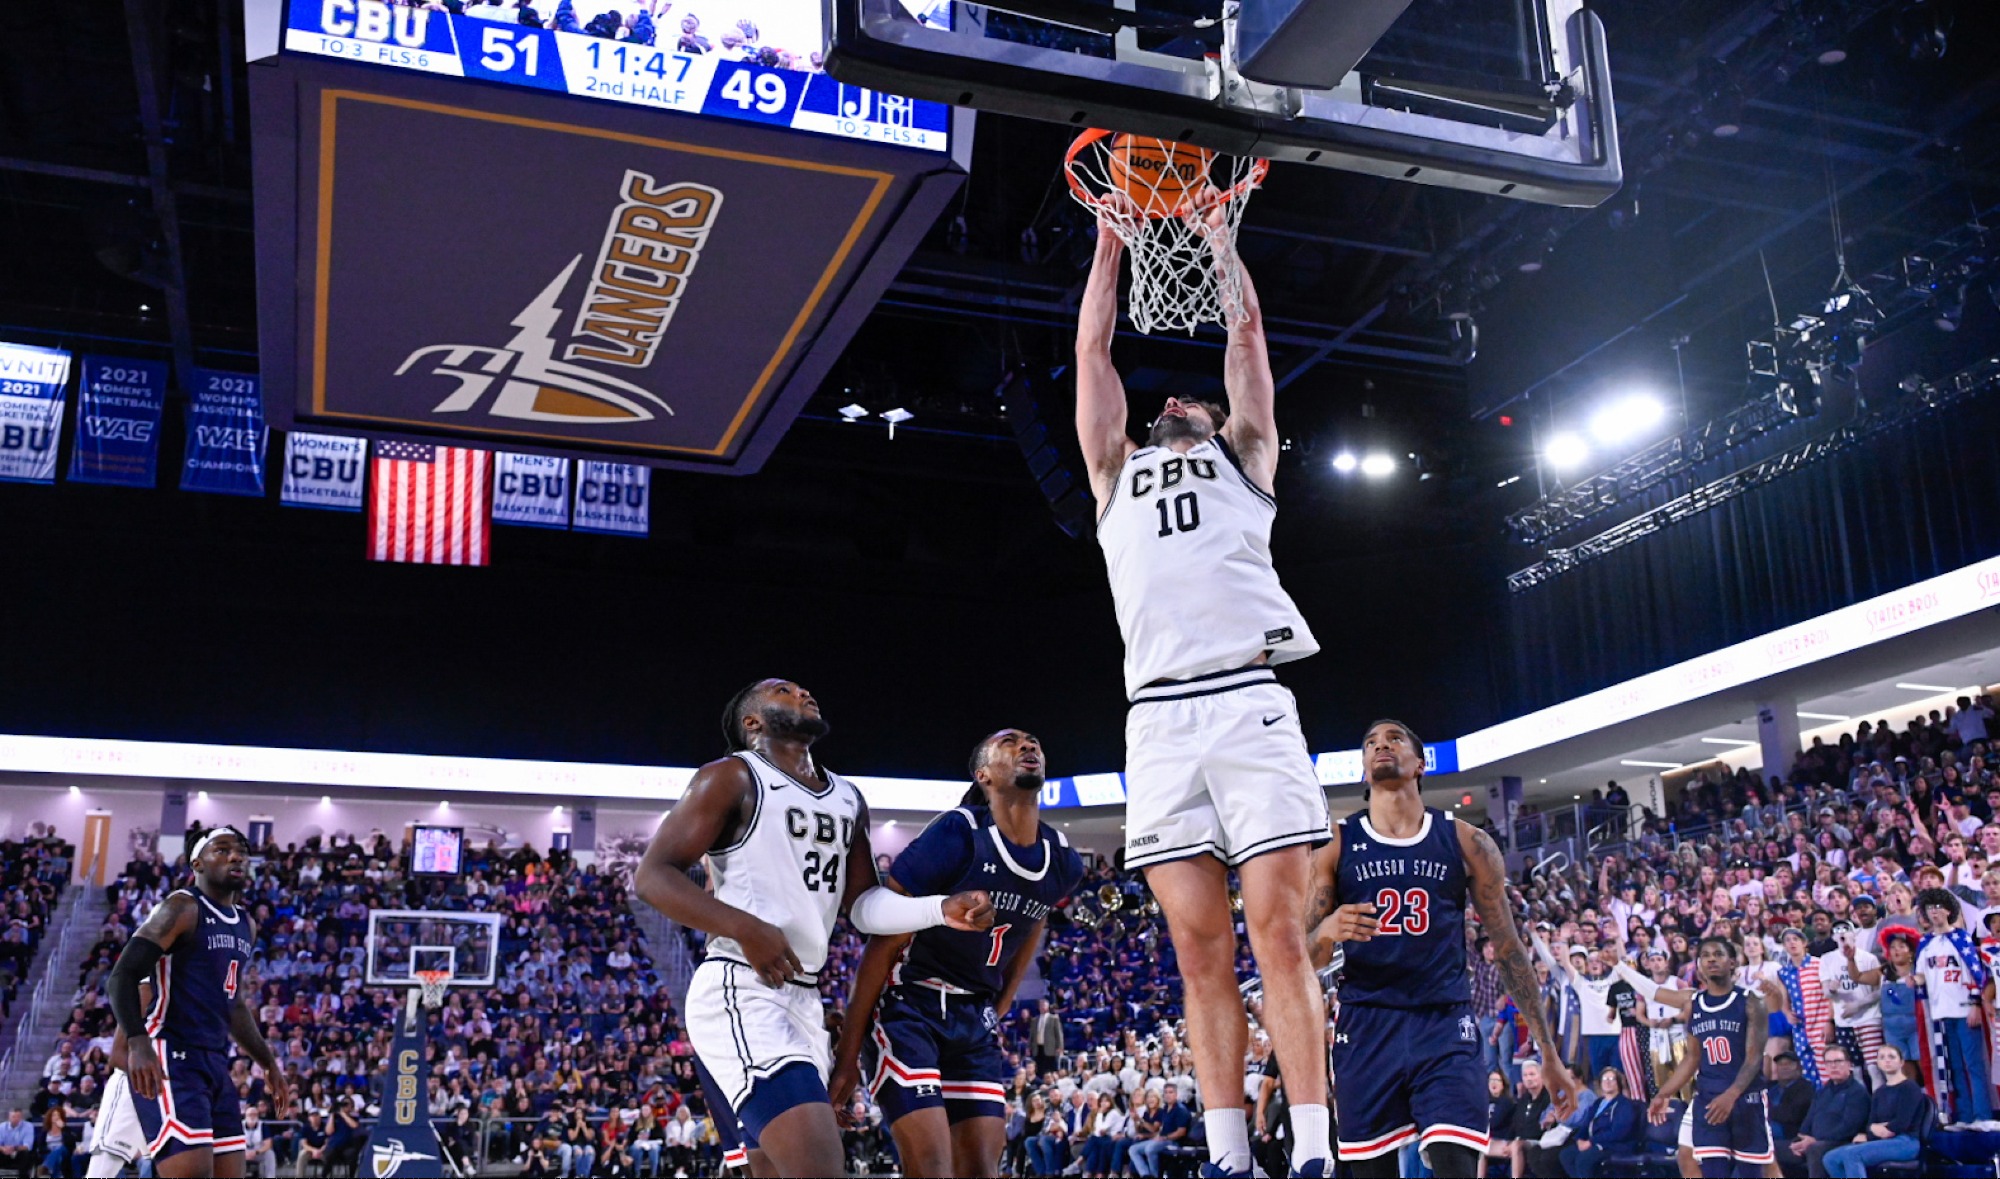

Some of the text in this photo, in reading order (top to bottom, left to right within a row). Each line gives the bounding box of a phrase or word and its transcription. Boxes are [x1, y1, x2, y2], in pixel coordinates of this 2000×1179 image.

[320, 0, 431, 49] CBU
[319, 37, 429, 67] TO:3 FLS:6
[480, 27, 540, 76] 51
[586, 42, 693, 83] 11:47
[585, 75, 687, 105] 2nd HALF
[721, 69, 787, 115] 49
[563, 169, 724, 369] LANCERS
[2, 381, 41, 396] 2021
[101, 366, 148, 385] 2021
[209, 377, 254, 394] 2021
[84, 392, 161, 410] BASKETBALL
[91, 383, 152, 398] WOMEN'S
[199, 393, 258, 408] WOMEN'S
[0, 402, 49, 411] OMEN'S
[191, 403, 263, 419] BASKETBAL
[2, 424, 52, 452] BU
[85, 415, 154, 442] WAC
[196, 425, 260, 452] WAC
[292, 437, 361, 453] WOMEN'S
[187, 458, 260, 474] CHAMPIONS
[290, 454, 358, 484] CBU
[513, 455, 555, 468] MEN'S
[593, 462, 635, 477] MEN'S
[284, 483, 361, 500] BASKETBALL
[499, 471, 565, 499] CBU
[1130, 456, 1219, 500] CBU
[579, 479, 645, 508] CBU
[494, 502, 566, 518] BASKETBALL
[575, 509, 648, 525] BASKETBALL
[1156, 491, 1200, 538] 10
[1977, 571, 2000, 600] STA
[1866, 591, 1939, 634] STATER BROS
[786, 805, 856, 849] CBU
[1128, 833, 1160, 849] LANCERS
[803, 851, 840, 893] 24
[1355, 859, 1448, 882] JACKSON STATE
[989, 890, 1021, 911] KSON
[1376, 887, 1430, 935] 23
[207, 933, 235, 950] JACKSON
[985, 923, 1013, 966] 1
[1927, 955, 1960, 969] USA
[223, 960, 239, 999] 4
[1944, 970, 1961, 983] 27
[1692, 1019, 1741, 1035] JACKSON STATE
[1703, 1036, 1731, 1066] 10
[394, 1049, 419, 1126] CBU
